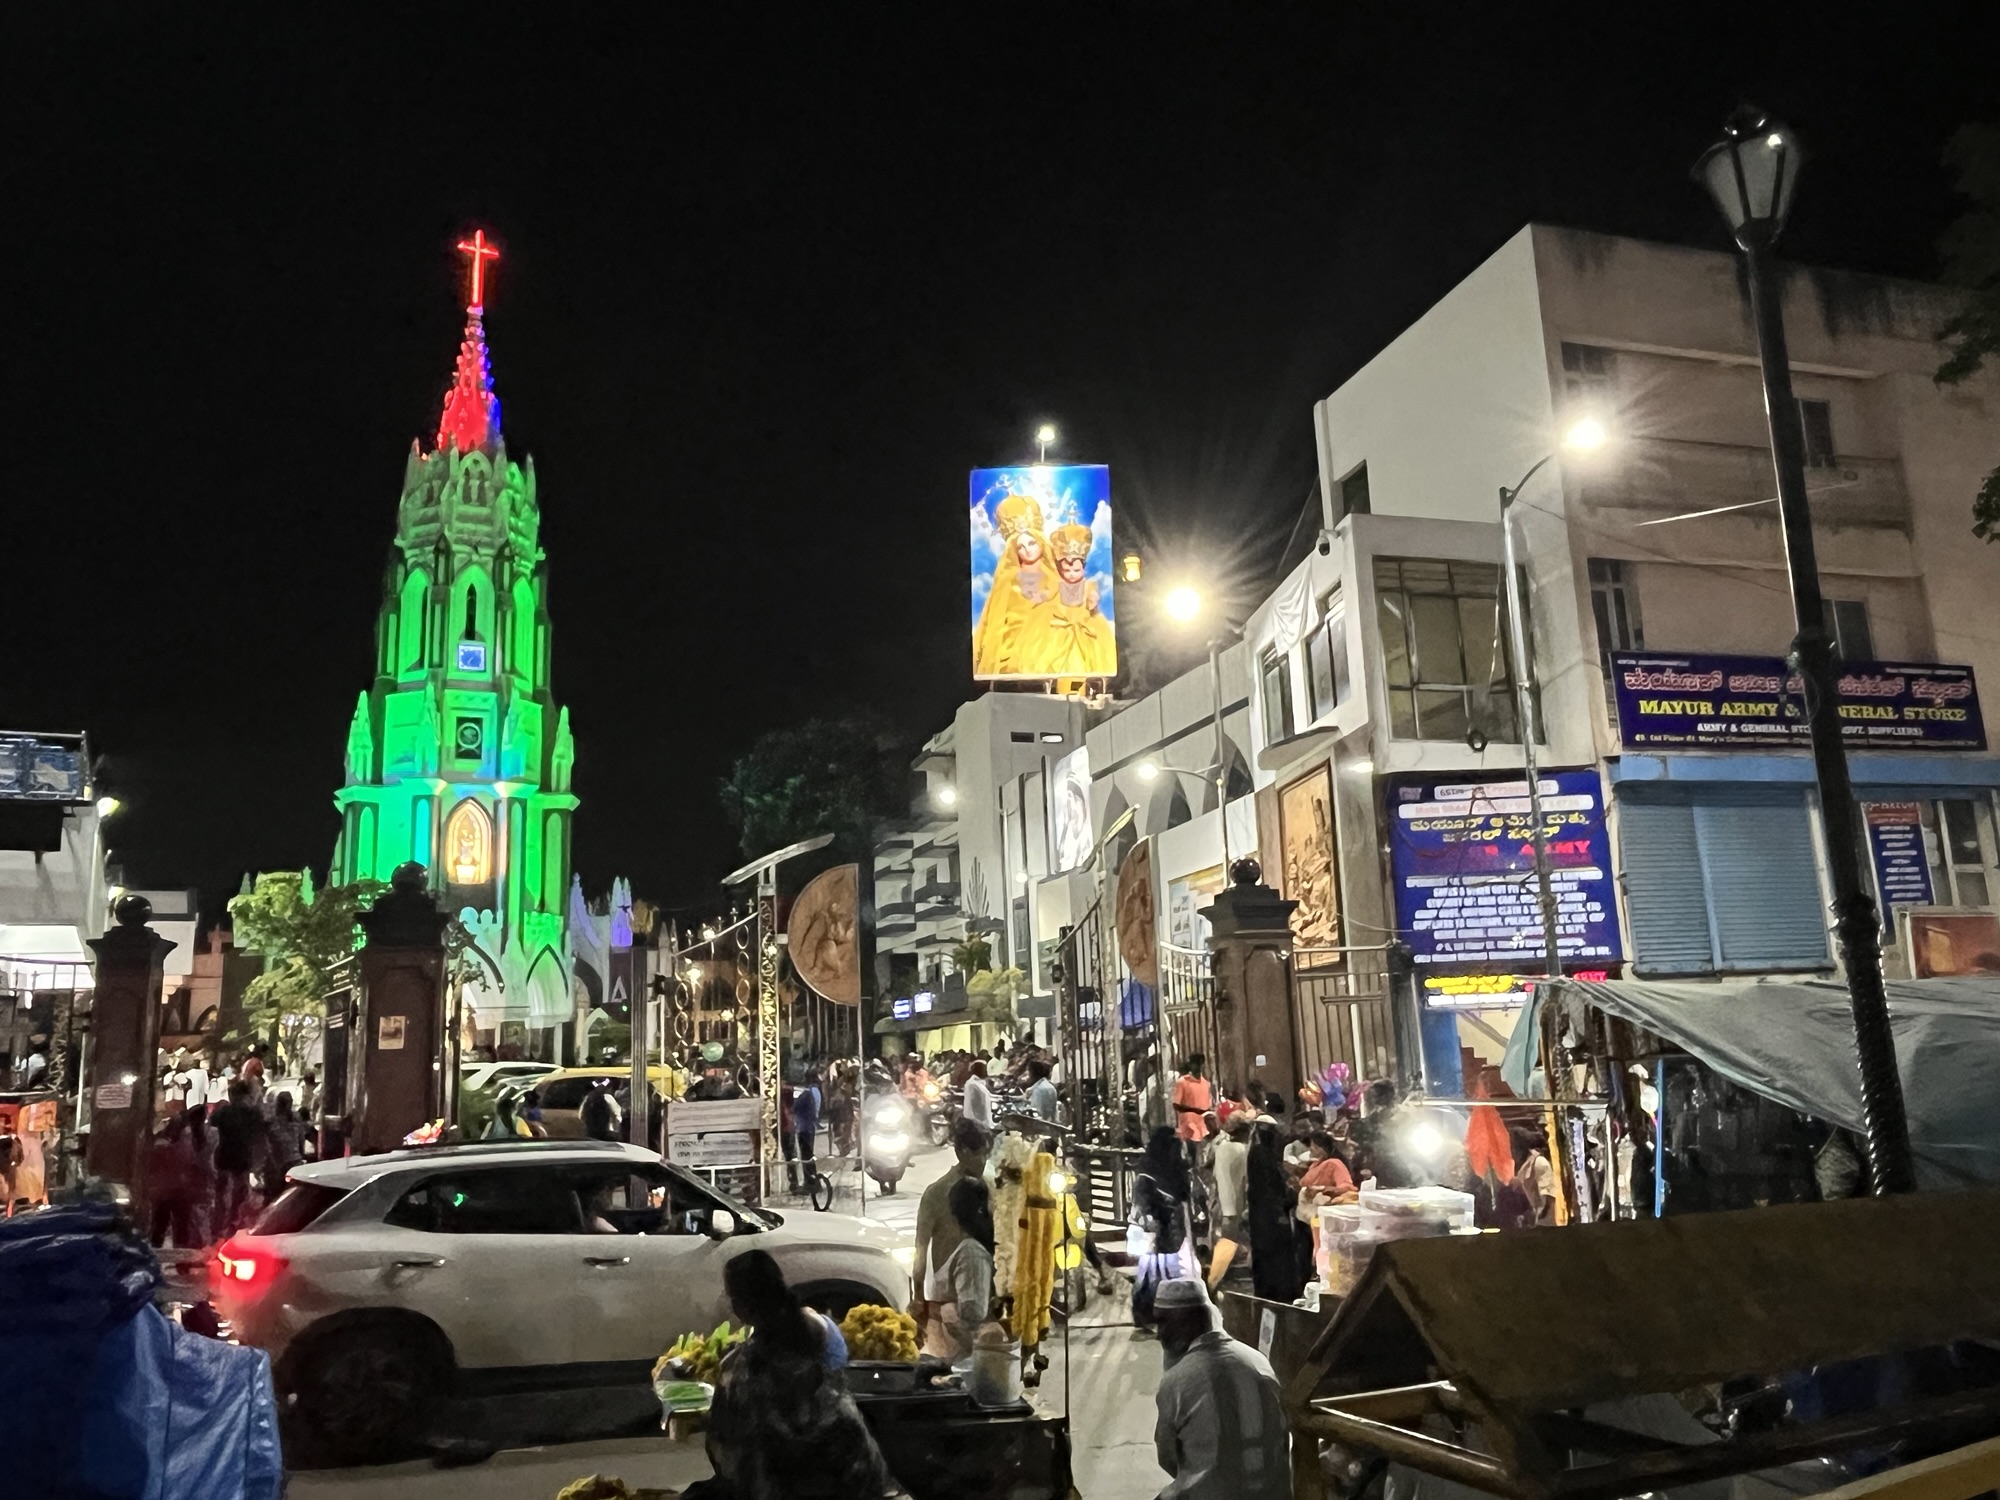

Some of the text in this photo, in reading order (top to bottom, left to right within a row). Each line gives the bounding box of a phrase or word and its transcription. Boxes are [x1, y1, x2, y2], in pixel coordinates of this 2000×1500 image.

[1639, 700, 1714, 715] MAYUR
[1720, 702, 1778, 716] ARMY
[1904, 706, 1967, 721] STORE
